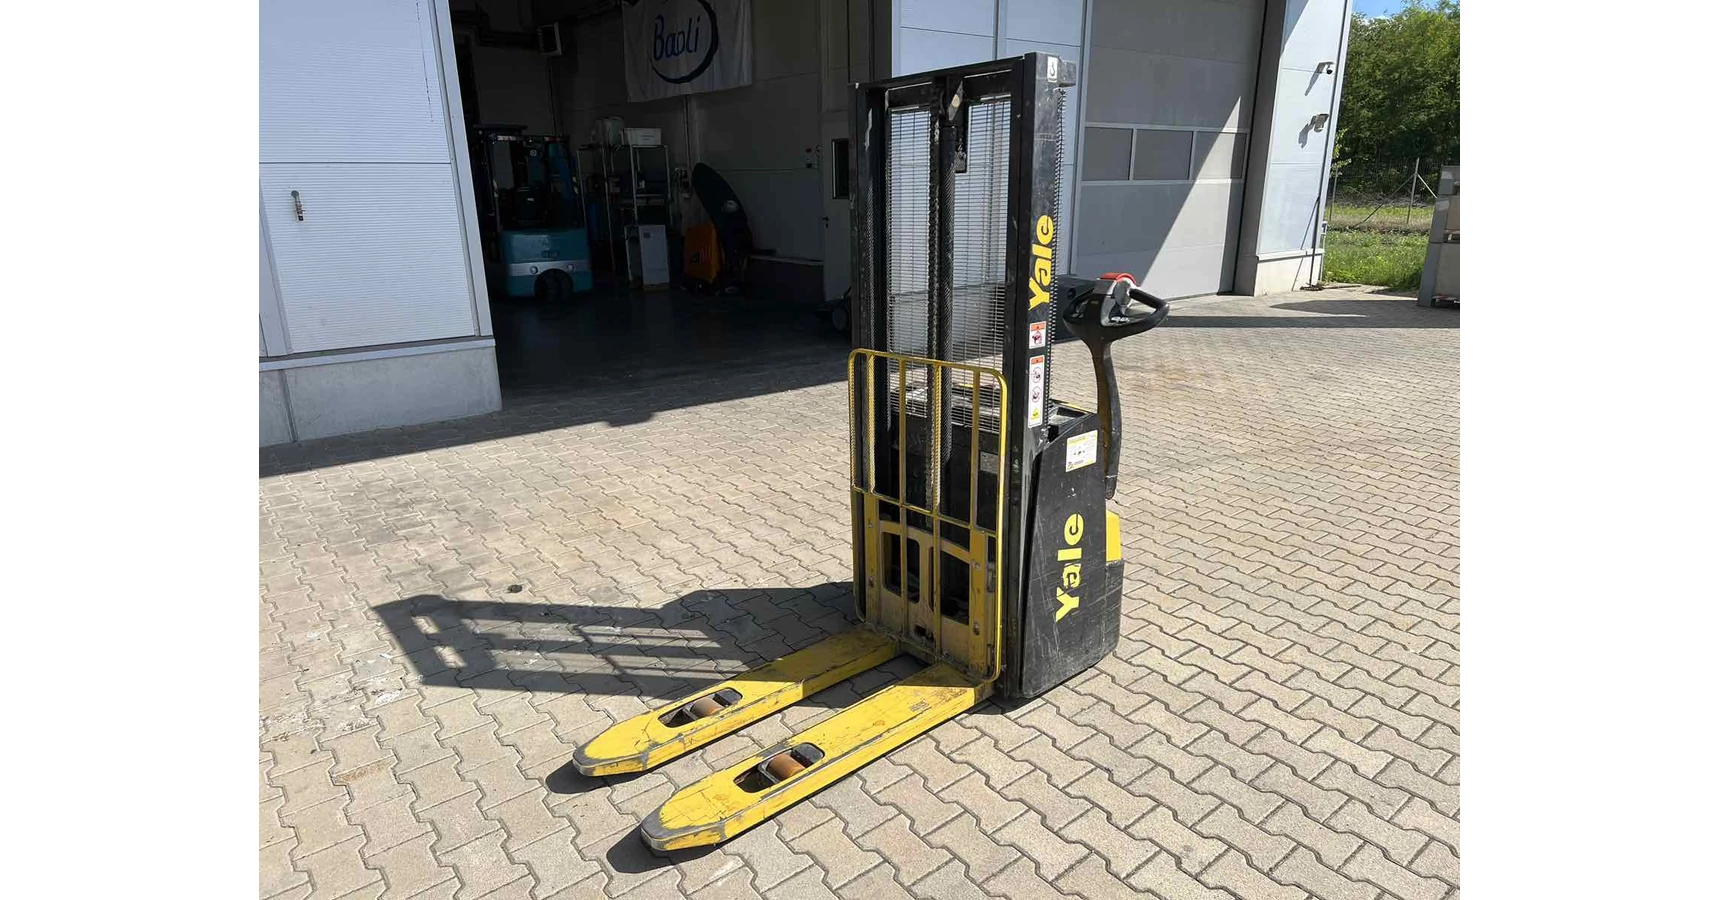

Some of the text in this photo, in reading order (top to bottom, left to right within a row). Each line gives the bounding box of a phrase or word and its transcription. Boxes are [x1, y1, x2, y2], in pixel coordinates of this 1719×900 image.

[653, 14, 701, 61] Baoli
[1028, 214, 1054, 311] Yale
[1055, 512, 1085, 623] Yale
